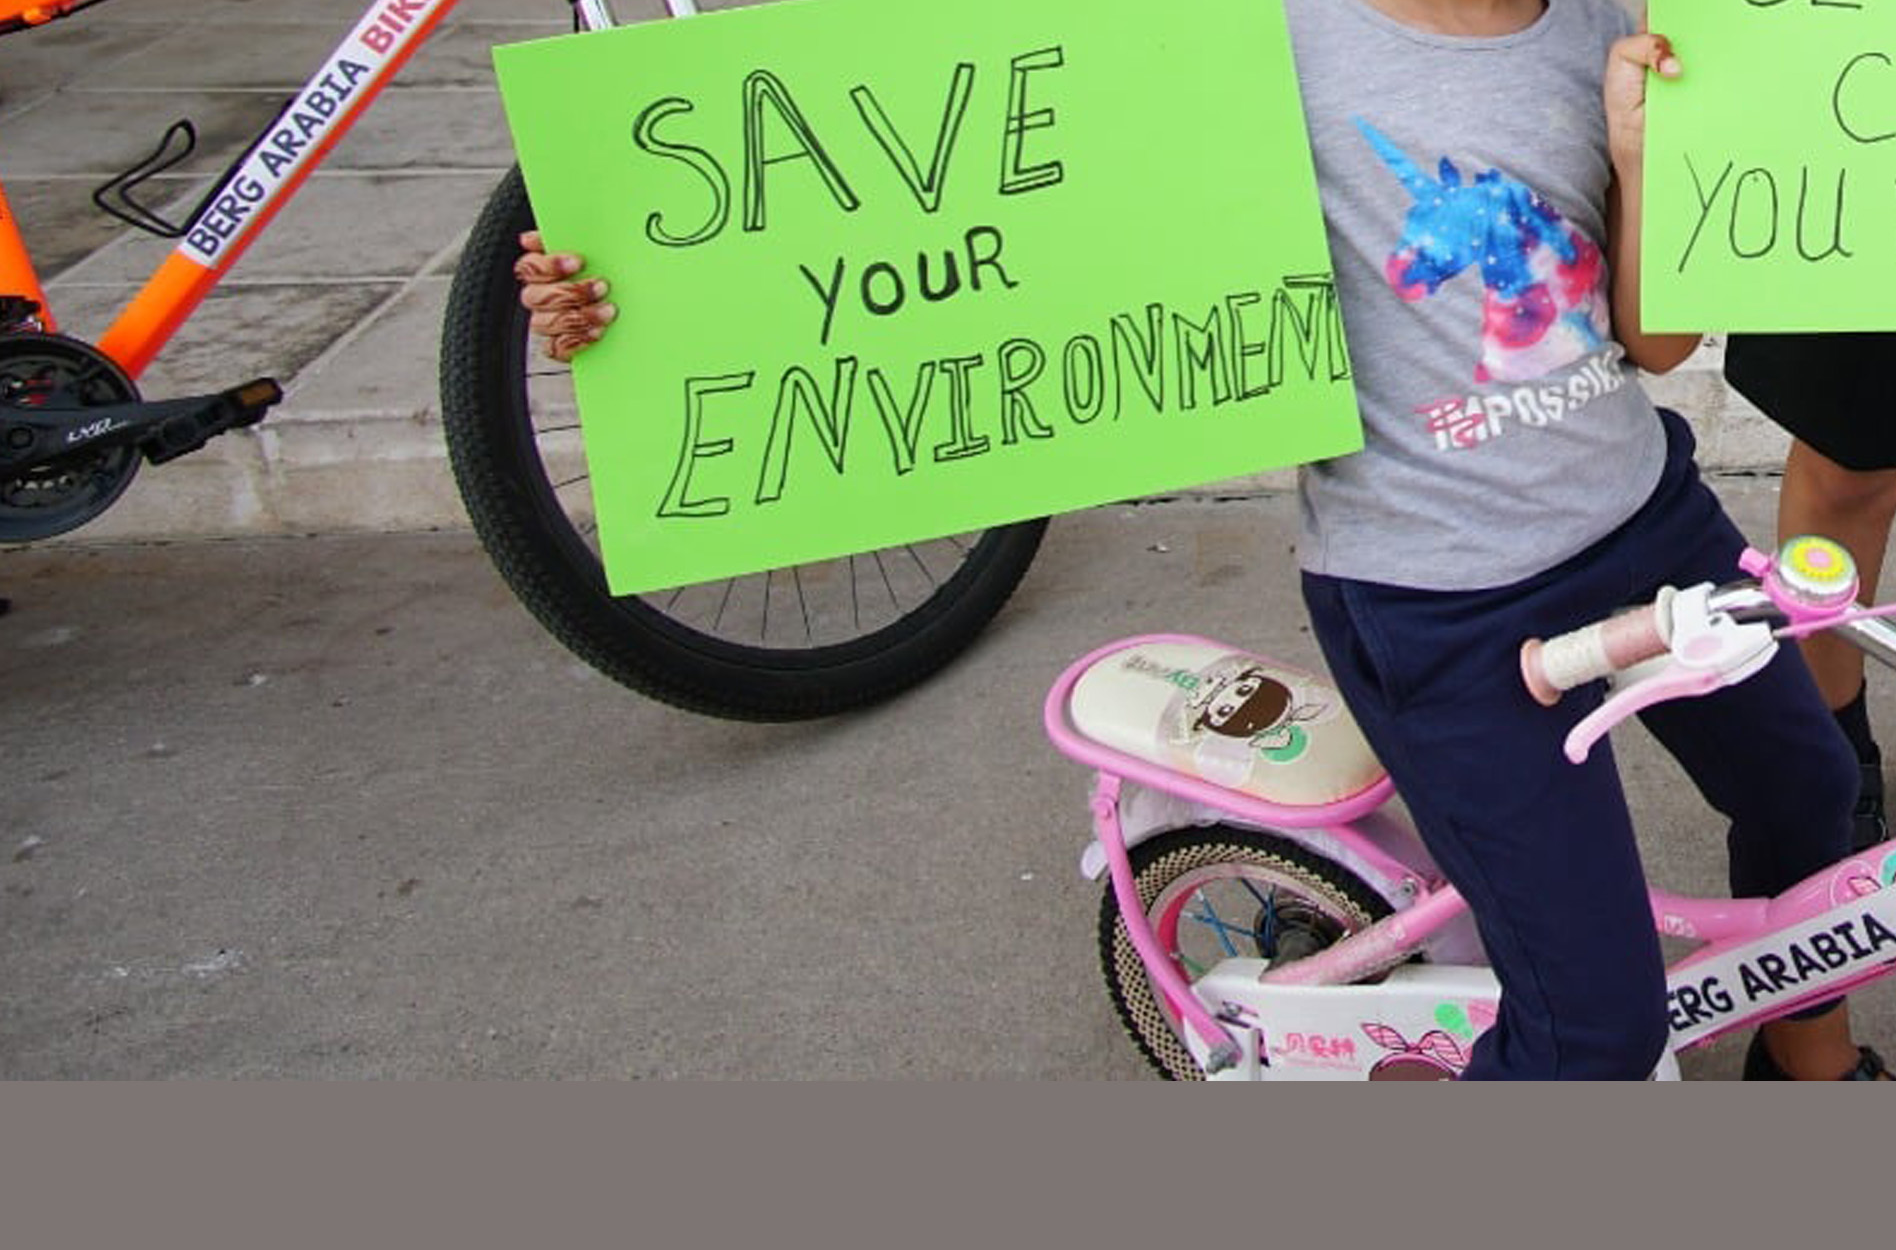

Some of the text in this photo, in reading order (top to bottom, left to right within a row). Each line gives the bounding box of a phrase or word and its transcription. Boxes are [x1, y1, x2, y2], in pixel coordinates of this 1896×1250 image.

[186, 174, 267, 258] BERG
[257, 57, 371, 179] ARABIA
[631, 45, 1064, 248] SAVE
[1677, 153, 1853, 273] YOU
[656, 272, 1353, 520] ENVIRONMENT
